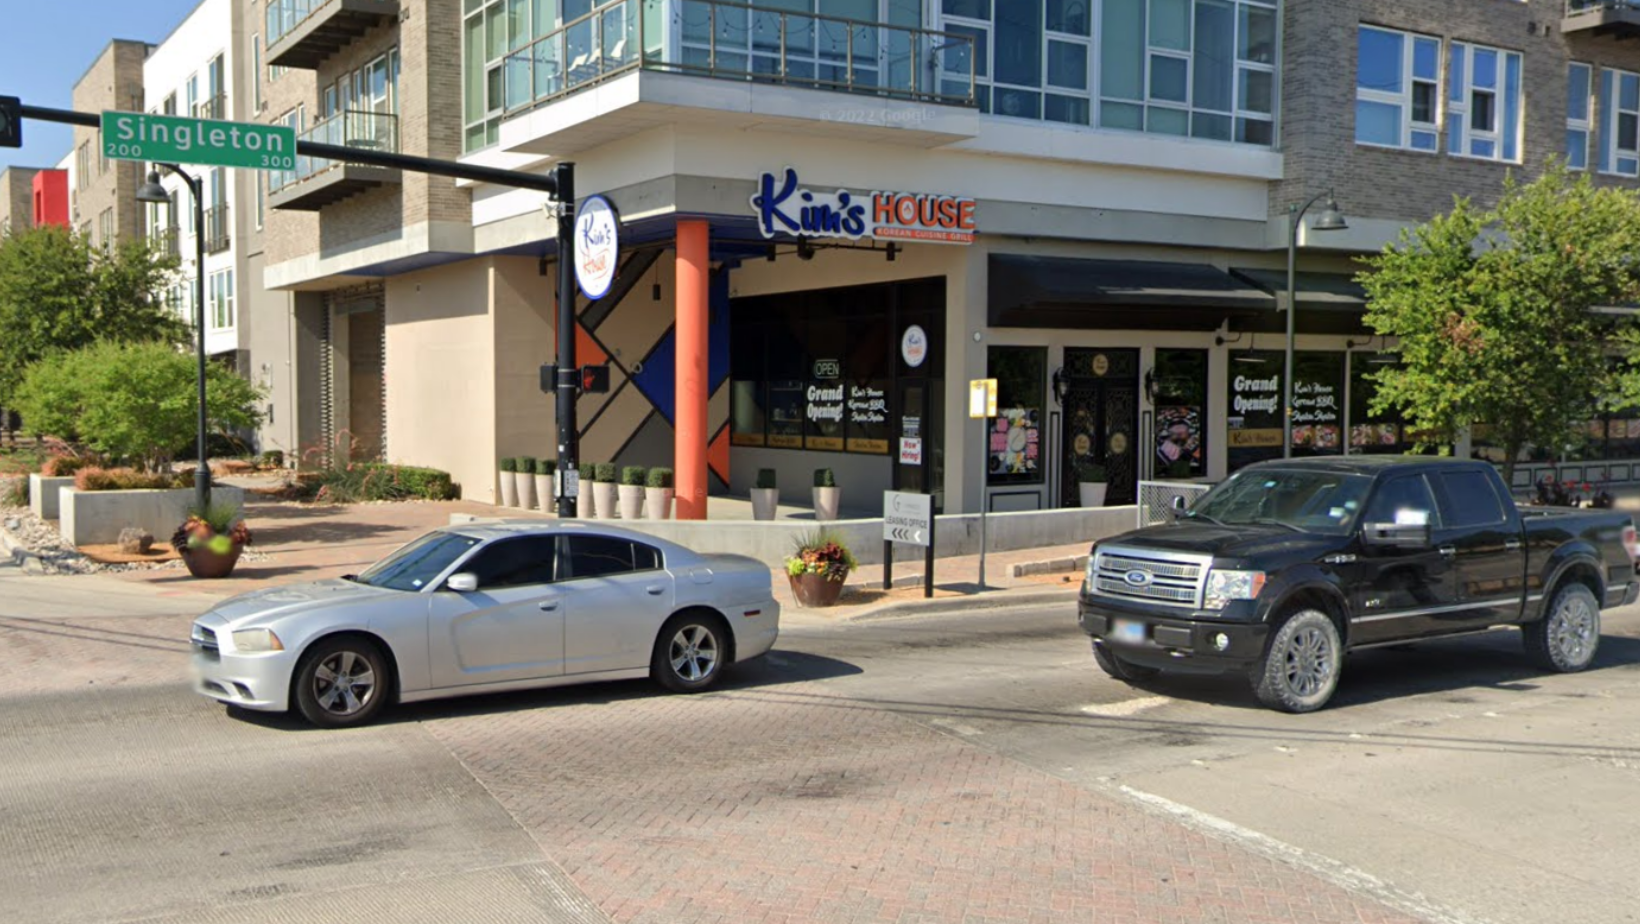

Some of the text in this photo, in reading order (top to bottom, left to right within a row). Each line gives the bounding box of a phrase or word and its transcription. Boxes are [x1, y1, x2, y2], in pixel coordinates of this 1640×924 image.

[117, 116, 283, 152] Singleton
[107, 143, 142, 158] 200
[260, 155, 293, 168] 300
[751, 168, 976, 237] Kim's HOUSE
[877, 227, 973, 242] KOREAN CUISINE GRILL
[815, 362, 840, 375] OPEN
[1234, 375, 1278, 392] Grand
[807, 384, 843, 401] Grand
[807, 402, 843, 422] Opening!
[1234, 394, 1278, 414] Opening!
[903, 440, 917, 449] Now
[886, 516, 928, 530] LEASING OFFICE
